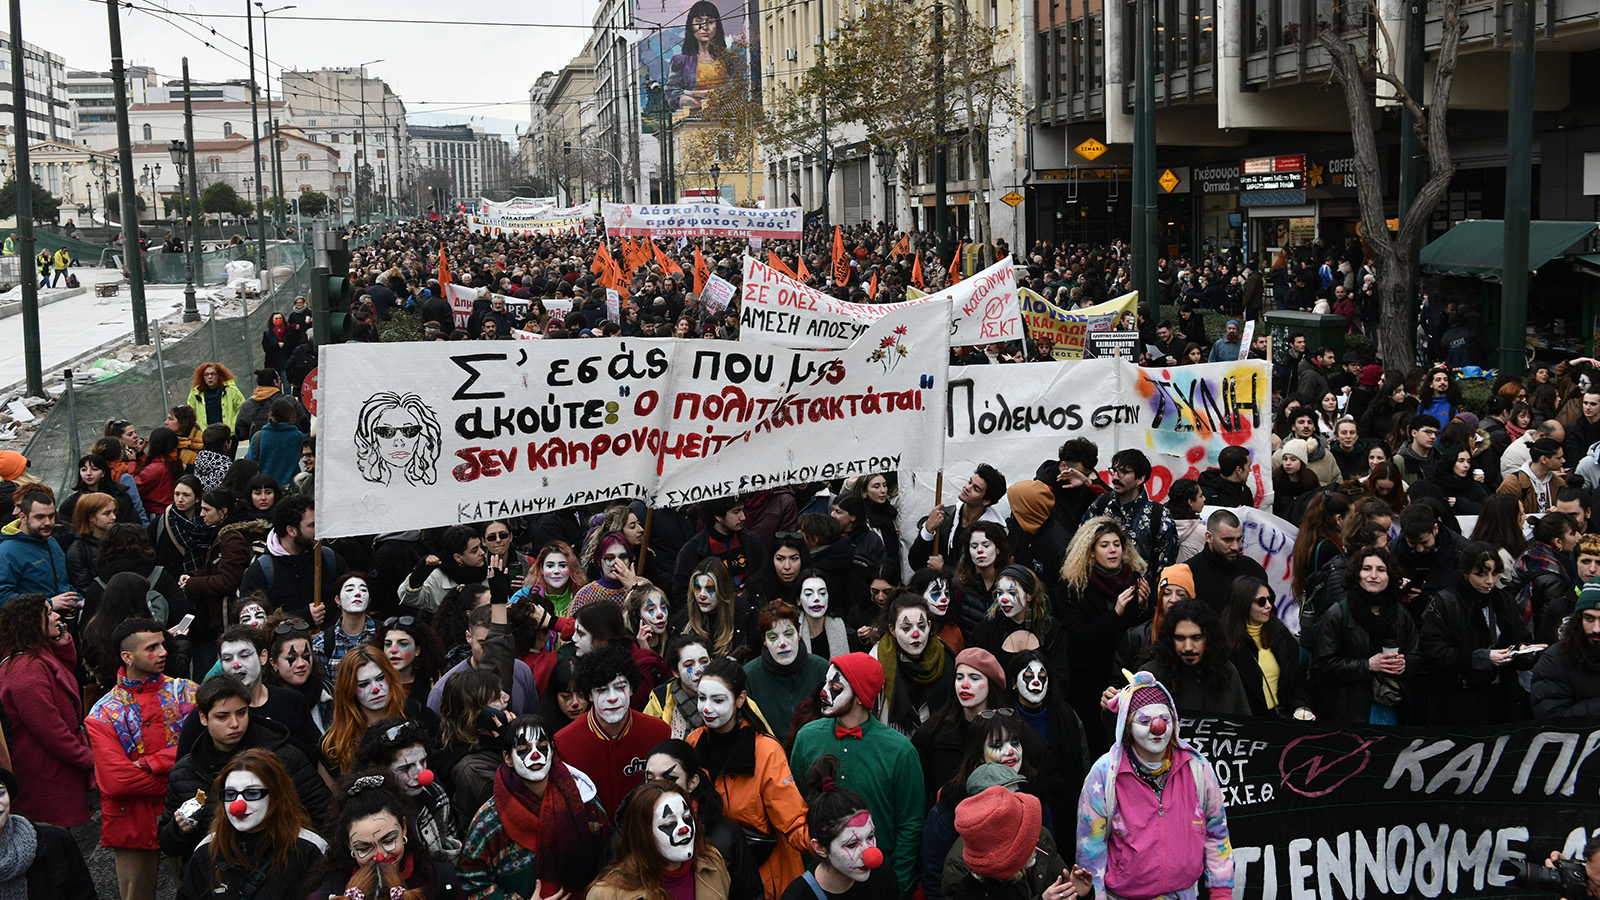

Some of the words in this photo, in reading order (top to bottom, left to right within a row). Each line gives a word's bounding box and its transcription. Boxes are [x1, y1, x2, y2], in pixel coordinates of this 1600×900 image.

[1194, 167, 1239, 180] Γκέσουρα
[1329, 159, 1354, 173] COFFE
[1203, 180, 1230, 192] Οπτικά
[1344, 174, 1357, 188] ISL
[639, 205, 720, 216] Δάσκαλος
[728, 209, 797, 219] σκυφτός
[747, 219, 791, 230] λαός!
[454, 297, 472, 309] Δημ
[744, 283, 770, 304] ΣΕ
[778, 289, 818, 311] ΟΛΕΣ
[741, 306, 801, 335] ΑΜΕΣΗ
[980, 318, 1018, 339] ΑΣΚΤ
[1033, 316, 1054, 329] ΚΑΙ
[1058, 325, 1087, 336] ΔΩΡ
[547, 342, 669, 386] εσάς
[692, 350, 774, 384] που
[455, 393, 620, 440] ακούτε:
[673, 385, 778, 422] πολιτ
[947, 378, 1084, 437] Πόλεμος
[1091, 404, 1141, 428] στην
[452, 446, 518, 482] δεν
[527, 425, 752, 477] κληρονομείτ
[457, 497, 557, 522] ΚΑΤΑΛΗΨΗ
[563, 482, 657, 507] ΔΡΑΜΑΤΙΚΣ
[666, 481, 734, 505] ΣΧΟΛΗΣ
[821, 452, 901, 478] ΘΕΑΤΡΟΥ
[1383, 735, 1511, 794] ΚΑΙ
[1512, 730, 1600, 796] ΠΡ
